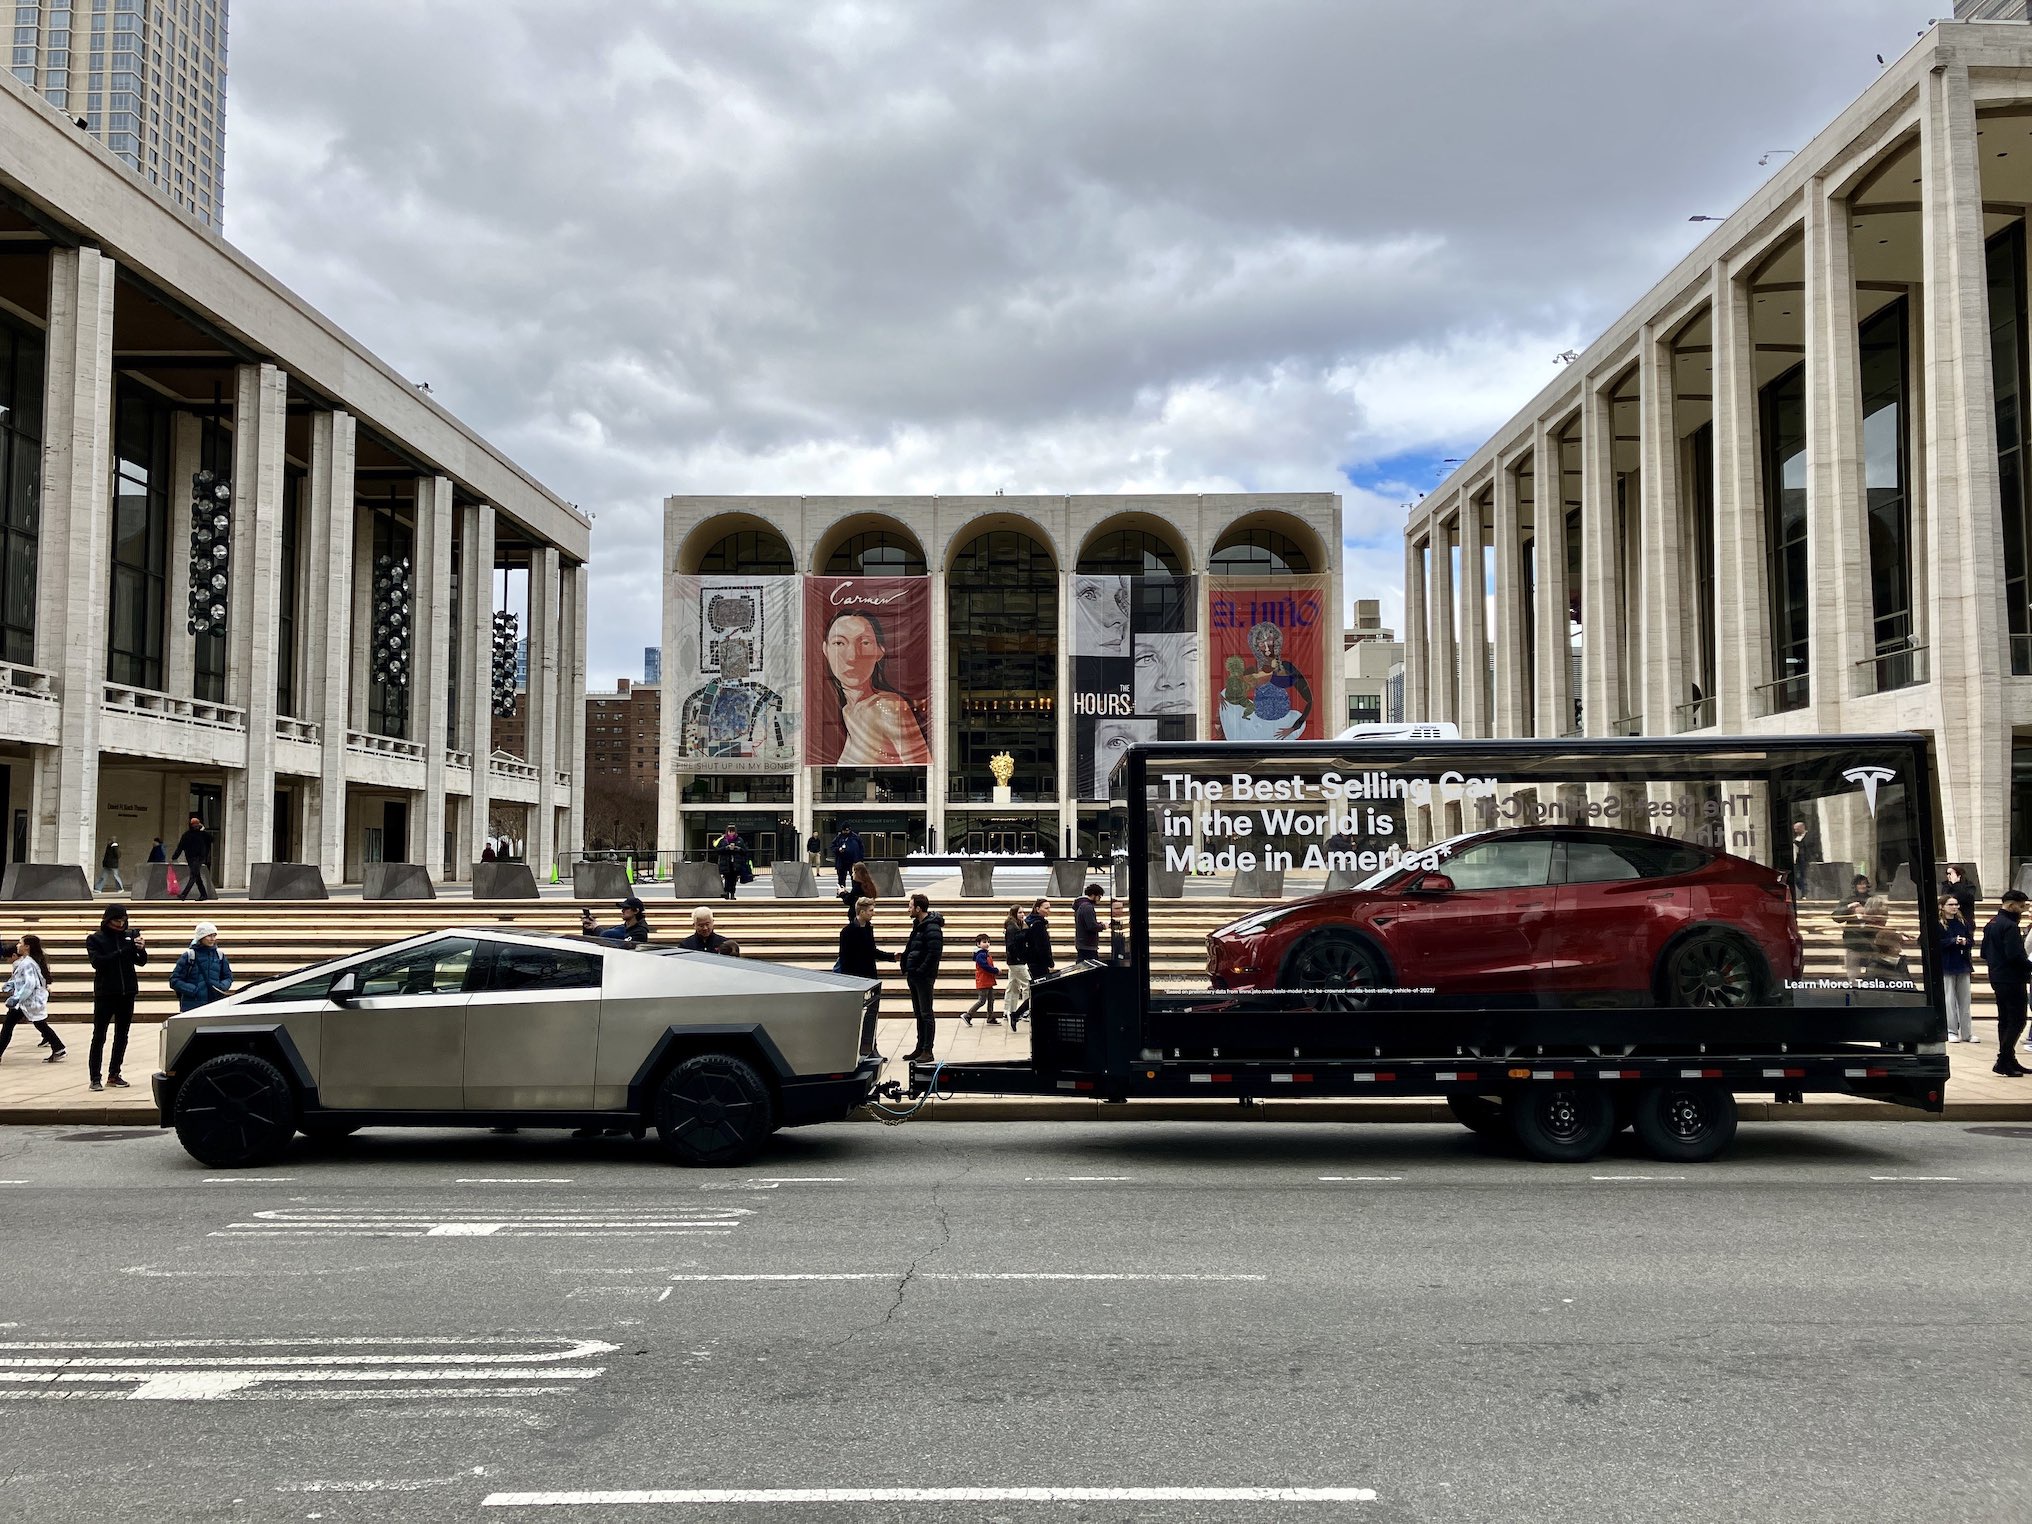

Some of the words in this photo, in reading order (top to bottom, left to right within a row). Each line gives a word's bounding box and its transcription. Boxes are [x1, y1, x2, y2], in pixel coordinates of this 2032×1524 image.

[830, 581, 909, 605] Carmen
[1214, 600, 1244, 627] EL
[1120, 684, 1130, 692] THE
[1073, 692, 1131, 716] HOURS
[697, 762, 719, 770] SHUT
[722, 762, 732, 770] UP
[736, 762, 745, 770] IN
[749, 762, 760, 770] MY
[764, 762, 794, 770] BONES
[1162, 774, 1223, 800] The
[1232, 771, 1430, 805] Best-Selling
[1439, 771, 1497, 799] Car
[1164, 809, 1191, 836] in
[1200, 809, 1252, 836] the
[1260, 808, 1358, 836] World
[1367, 807, 1393, 835] is
[1165, 845, 1256, 872] Made
[1265, 844, 1292, 871] in
[1784, 979, 1816, 989] Learn
[1820, 979, 1853, 989] More:
[1855, 978, 1914, 989] Tesla.com
